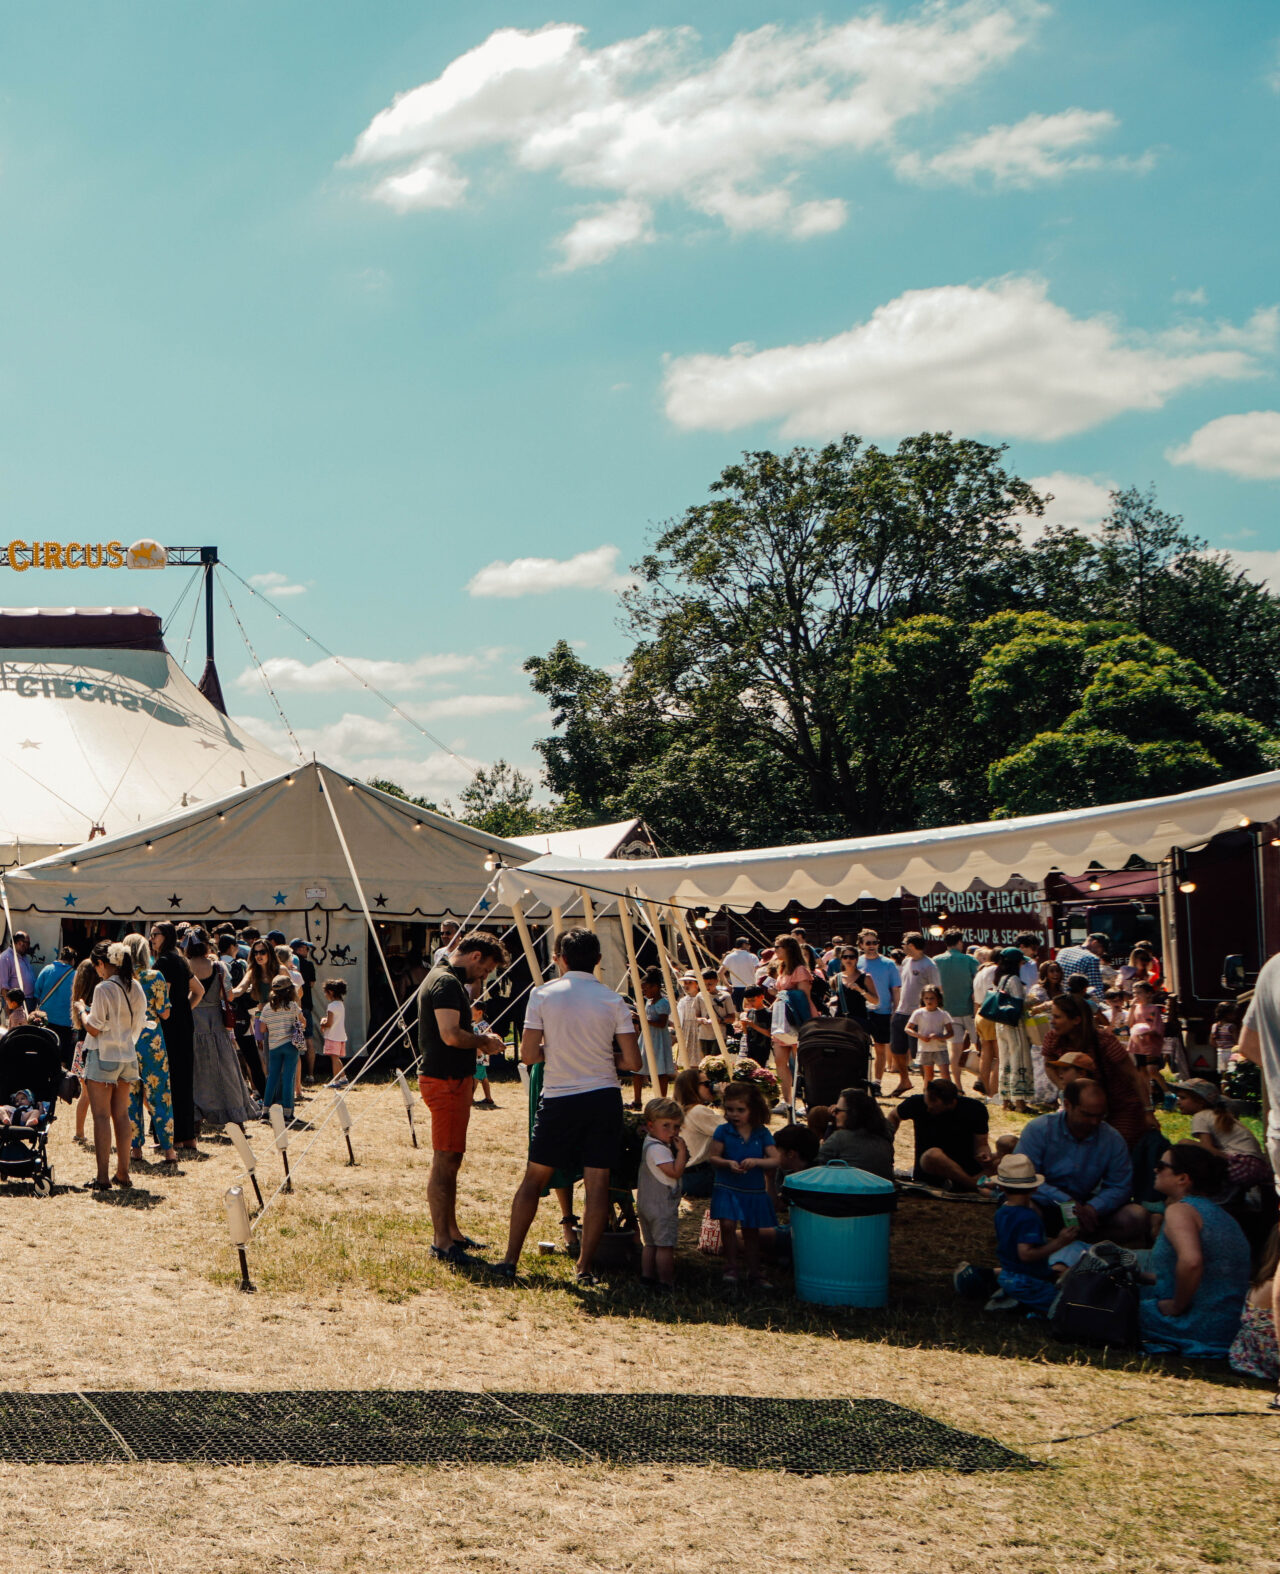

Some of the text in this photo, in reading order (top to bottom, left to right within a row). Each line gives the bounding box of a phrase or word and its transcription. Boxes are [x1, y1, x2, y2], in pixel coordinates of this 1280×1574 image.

[7, 539, 124, 572] CIRCUS
[920, 890, 1041, 914] GIFFORDS CIRCUS
[992, 929, 999, 944] &
